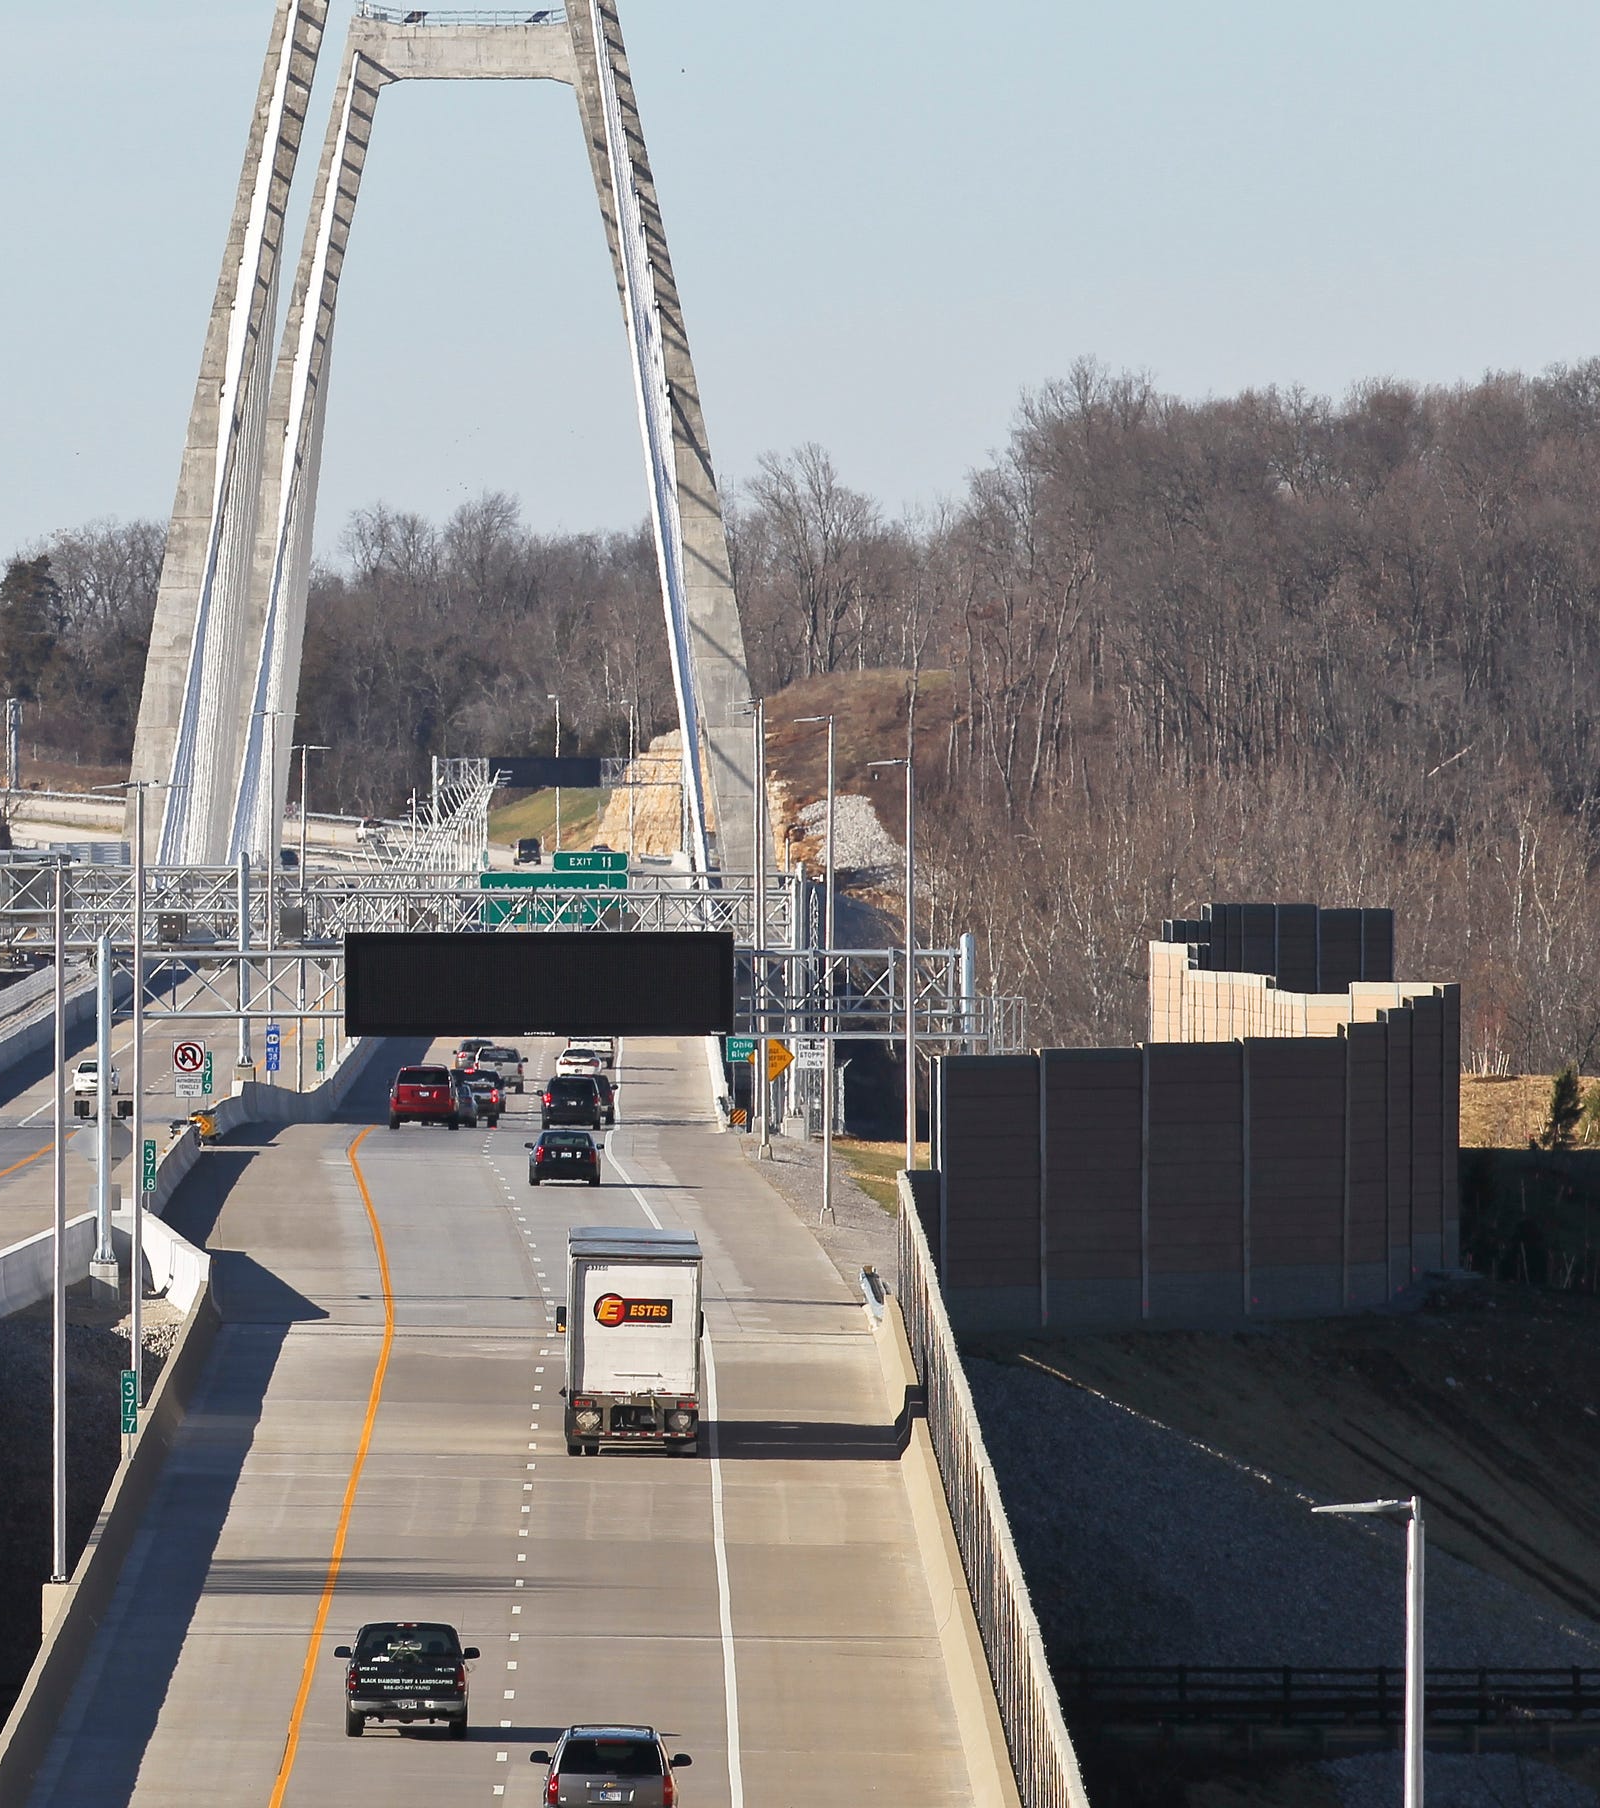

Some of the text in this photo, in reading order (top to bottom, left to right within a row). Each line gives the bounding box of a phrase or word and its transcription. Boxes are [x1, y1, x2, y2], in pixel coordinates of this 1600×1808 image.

[569, 856, 612, 867] EXIT 11
[732, 1040, 753, 1048] Ohio
[731, 1049, 750, 1058] Rive
[596, 1299, 668, 1320] E ESTES
